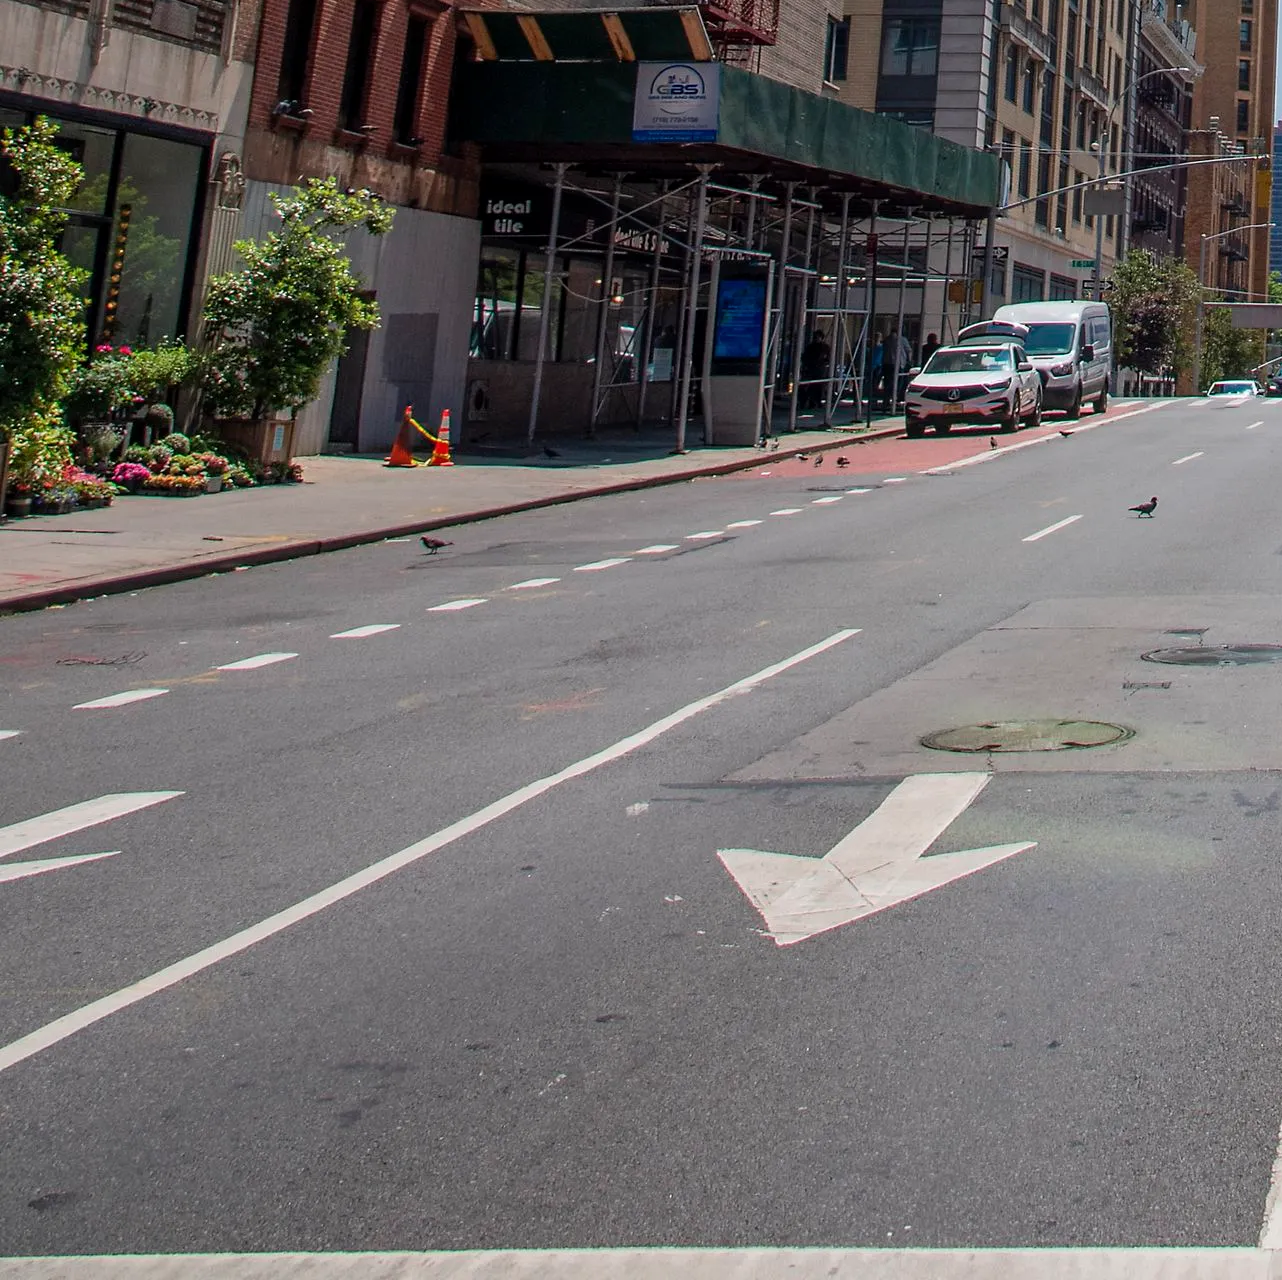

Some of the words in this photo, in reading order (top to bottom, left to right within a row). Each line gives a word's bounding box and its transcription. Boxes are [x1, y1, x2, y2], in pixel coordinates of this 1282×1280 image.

[657, 84, 698, 95] GBS
[486, 200, 531, 214] ideal
[494, 219, 523, 233] tile
